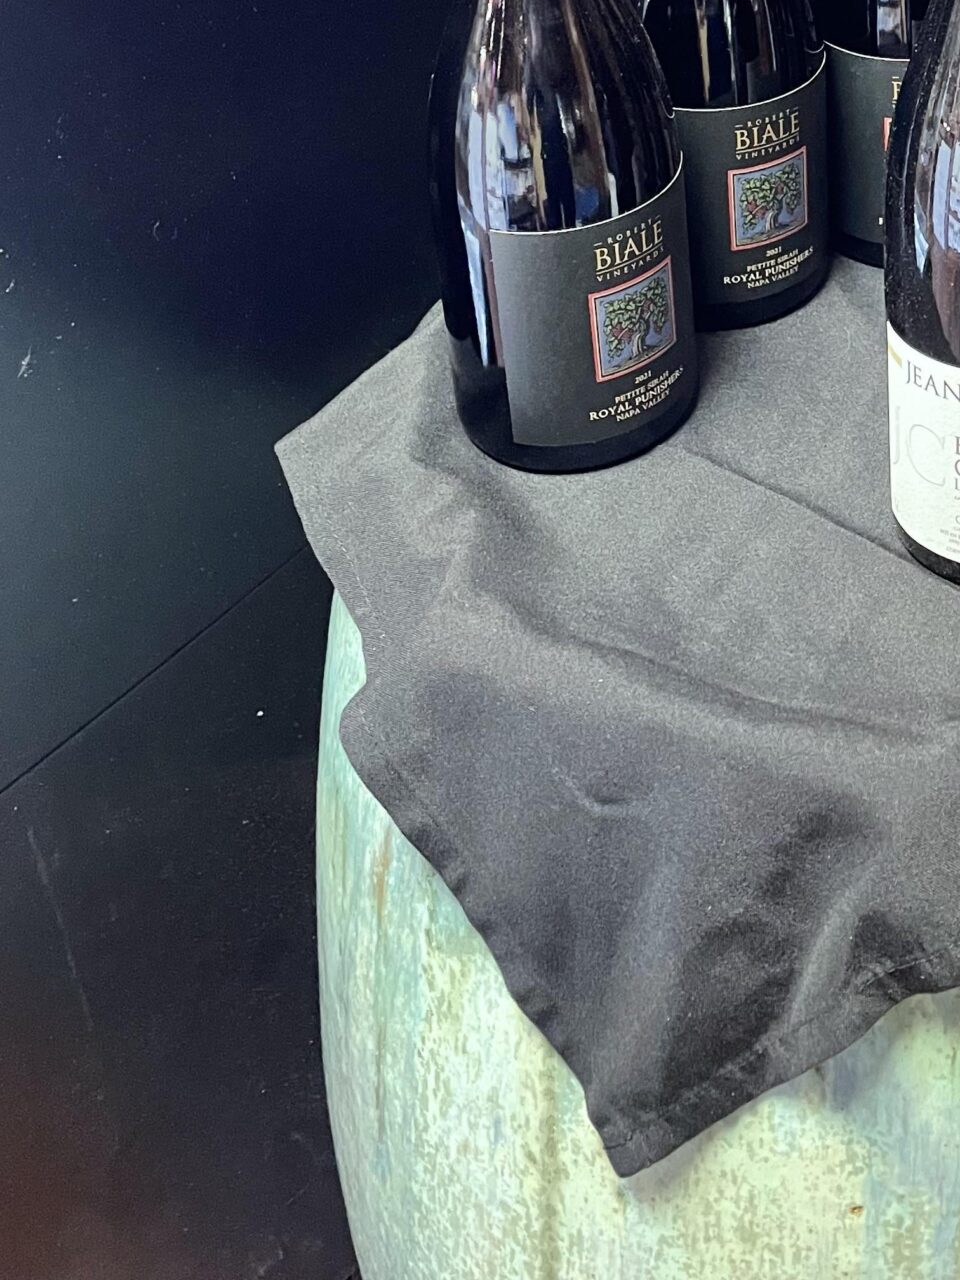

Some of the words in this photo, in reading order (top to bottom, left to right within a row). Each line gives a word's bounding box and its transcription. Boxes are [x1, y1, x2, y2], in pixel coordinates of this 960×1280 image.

[734, 111, 800, 151] BIALE
[736, 134, 800, 161] VINEYARDS
[594, 220, 663, 271] BIALE
[607, 218, 652, 244] ROBERT
[597, 245, 664, 282] VINEYARDS
[723, 271, 762, 284] ROYAL
[765, 245, 814, 277] PUNISHERS
[746, 259, 776, 272] PETITE
[777, 248, 799, 264] SIRAH
[747, 279, 770, 289] NAPA
[771, 265, 799, 282] VALLEY
[590, 402, 632, 421] ROYAL
[635, 365, 684, 406] PUNISHERS
[615, 385, 646, 404] PETITE
[647, 370, 669, 390] SIRAH
[635, 370, 652, 384] 2021
[616, 408, 640, 422] NAPA
[642, 388, 670, 410] VALLEY
